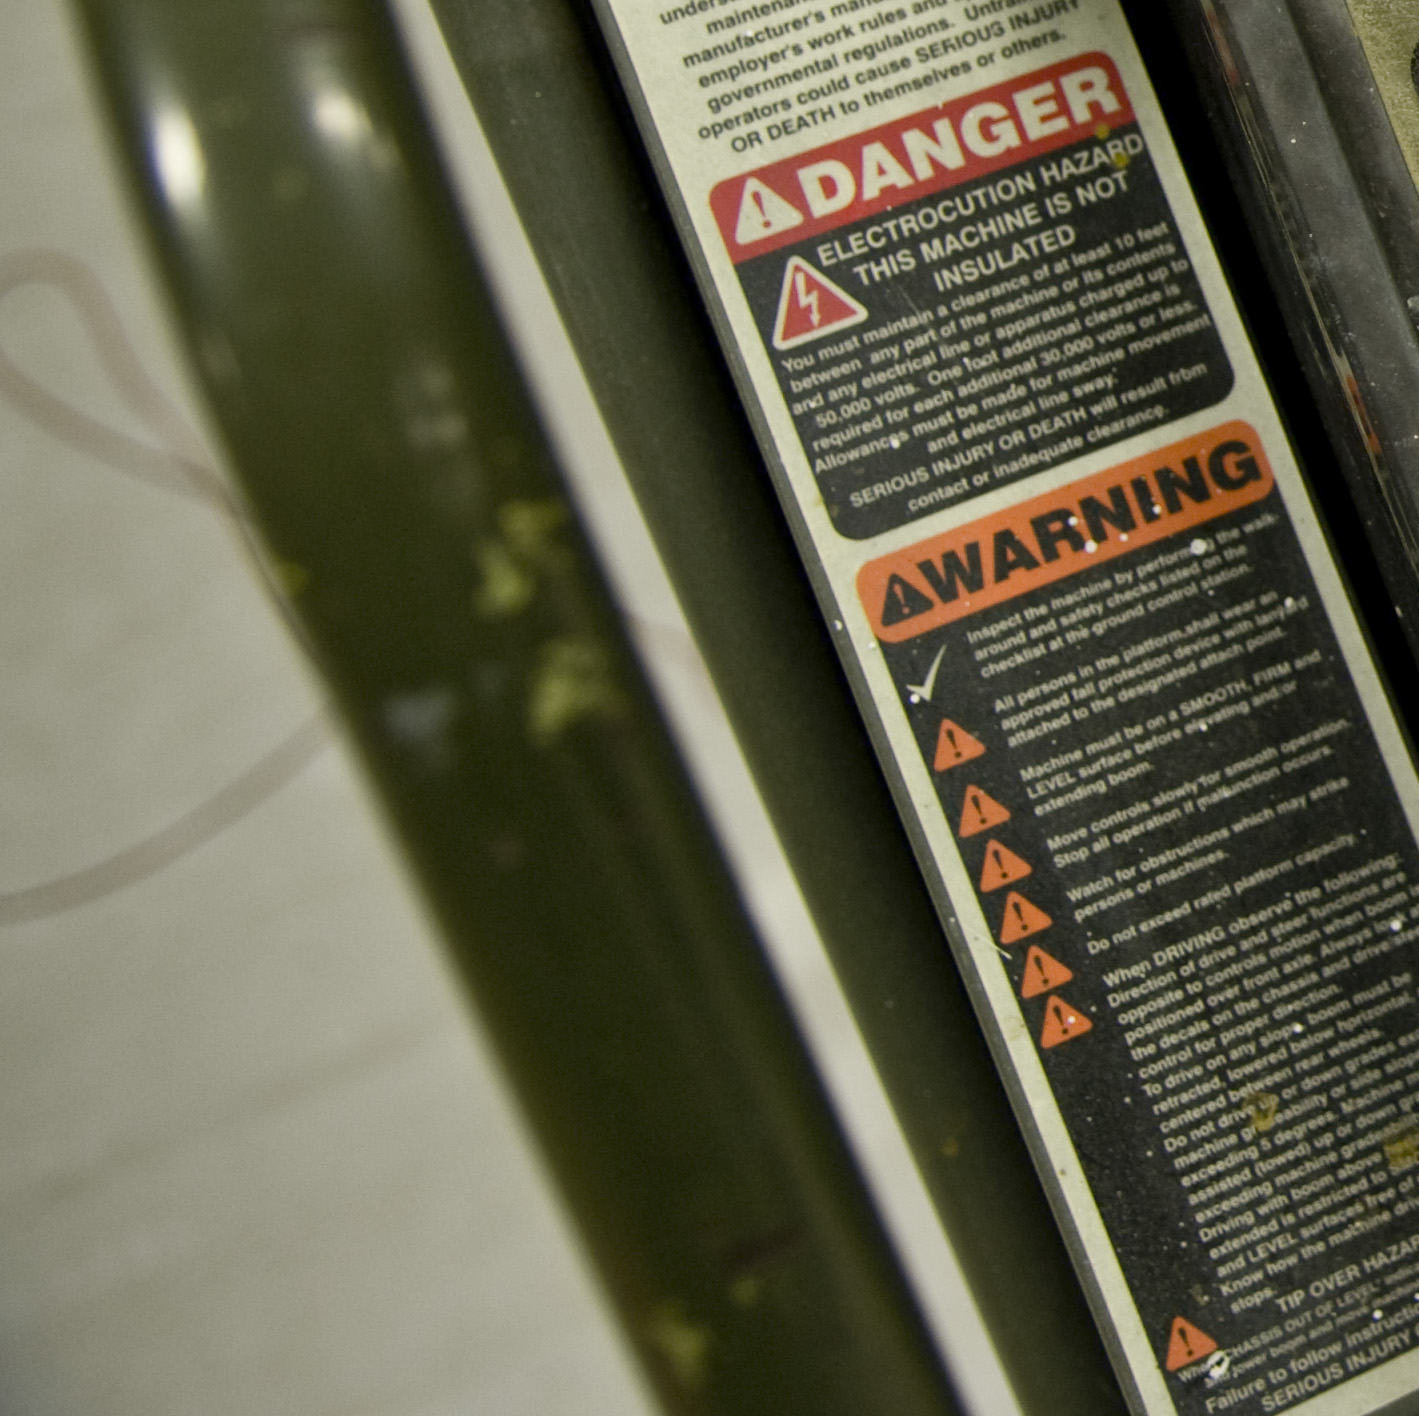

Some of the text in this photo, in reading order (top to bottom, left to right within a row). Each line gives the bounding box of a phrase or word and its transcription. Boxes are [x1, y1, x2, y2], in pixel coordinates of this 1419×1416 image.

[681, 10, 825, 66] manufacturer's
[696, 43, 803, 87] employer's
[807, 23, 854, 50] work
[858, 8, 907, 32] rules
[696, 98, 792, 139] operators
[795, 74, 850, 105] could
[854, 56, 911, 84] cause
[915, 21, 1004, 63] SERIOUS
[706, 53, 839, 112] governmental
[729, 31, 1068, 151] OR DEATH to themselves or others.
[796, 65, 1121, 215] DANGER
[815, 132, 1146, 266] ELECTROCUTION HAZARD
[852, 169, 1133, 287] THIS MACHINE IS NOT
[932, 223, 1078, 291] INSULATED
[781, 219, 1169, 373] You must maintain a clearance of at least 10 feet
[788, 242, 1176, 392] between any part of the machine or its contents
[811, 412, 883, 450] required
[884, 406, 909, 423] for
[912, 386, 954, 413] each
[956, 355, 1037, 396] additional
[1097, 321, 1136, 344] volts
[1138, 314, 1156, 328] or
[925, 428, 958, 451] and
[961, 400, 1036, 438] electrical
[1037, 391, 1069, 410] line
[848, 466, 929, 506] SERIOUS
[931, 441, 995, 475] INJURY
[998, 430, 1026, 450] OR
[1028, 407, 1087, 438] DEATH
[1090, 395, 1118, 416] will
[1120, 377, 1167, 404] result
[906, 475, 969, 510] contact
[971, 471, 989, 485] or
[992, 435, 1084, 477] inadequate
[917, 439, 1262, 602] WARNING
[1274, 1287, 1306, 1312] TIP
[1307, 1263, 1360, 1297] OVER
